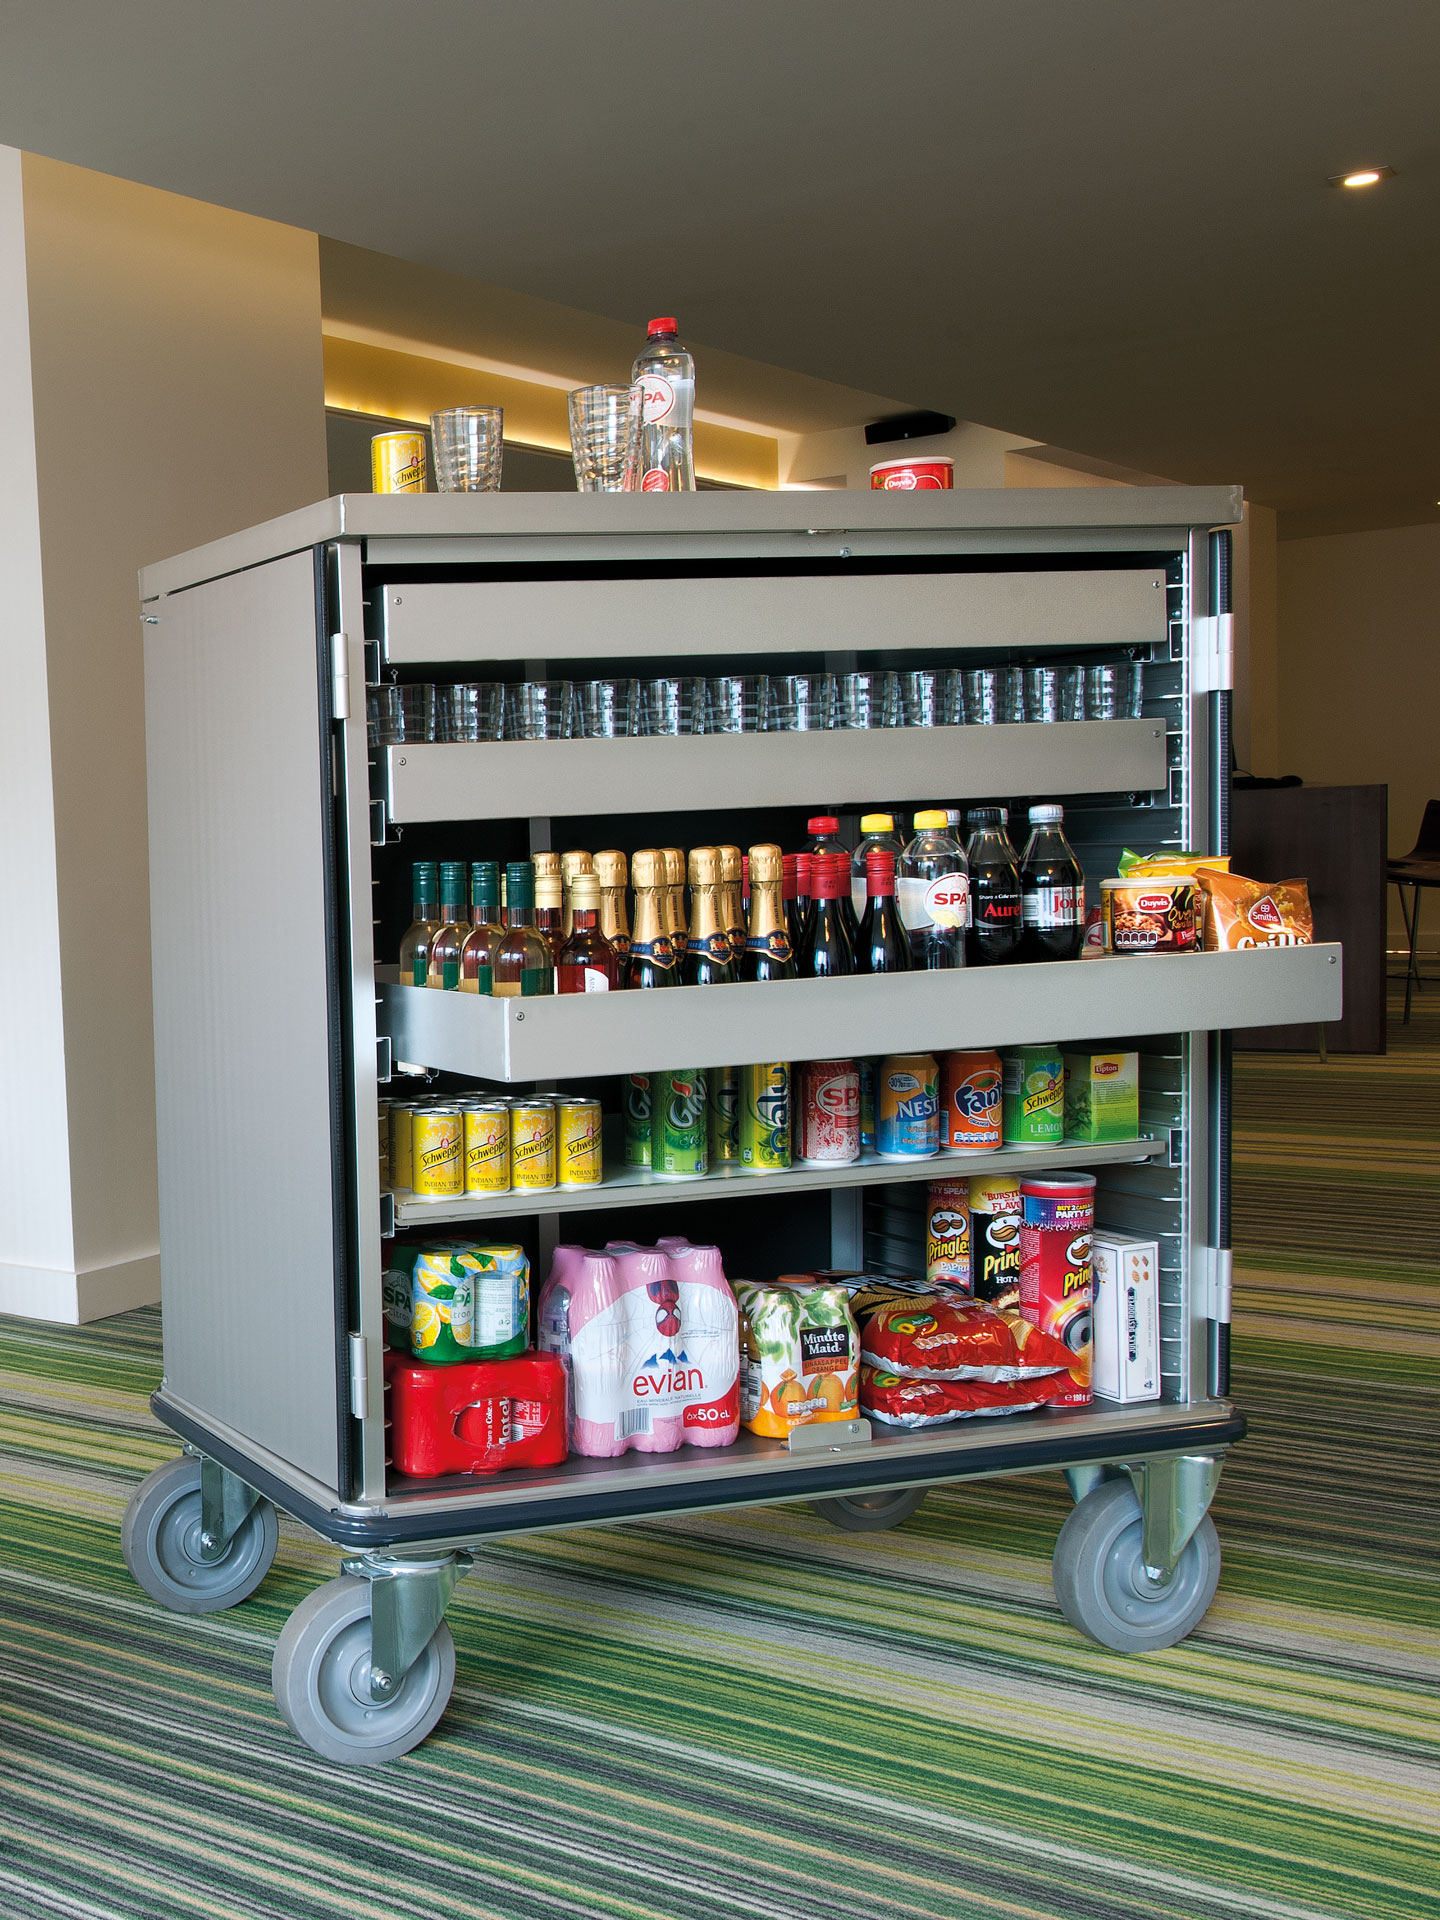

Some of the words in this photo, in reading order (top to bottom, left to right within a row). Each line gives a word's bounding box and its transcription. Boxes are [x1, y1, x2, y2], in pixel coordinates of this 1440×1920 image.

[889, 478, 912, 488] Duyvis
[934, 892, 967, 905] SPA
[1140, 899, 1169, 909] Duyvis
[1252, 911, 1279, 923] Smiths
[1095, 1064, 1118, 1073] Lipton
[823, 1087, 859, 1107] SP
[955, 1080, 1002, 1117] Fant
[1026, 1086, 1063, 1111] Schwepp
[896, 1096, 939, 1118] NEST
[469, 1138, 509, 1163] Schweppe
[567, 1132, 600, 1156] Schwepp
[422, 1140, 462, 1167] Schweppe
[424, 1180, 447, 1188] INDIAN
[1056, 1210, 1084, 1219] PARTY
[940, 1261, 969, 1272] PAPRI
[984, 1250, 1020, 1281] Pring
[383, 1286, 412, 1313] SPA
[452, 1291, 471, 1308] PA
[803, 1331, 846, 1345] Minute
[804, 1358, 847, 1369] SINAASAPPEL
[811, 1365, 839, 1374] ORANGE
[633, 1368, 704, 1397] evian
